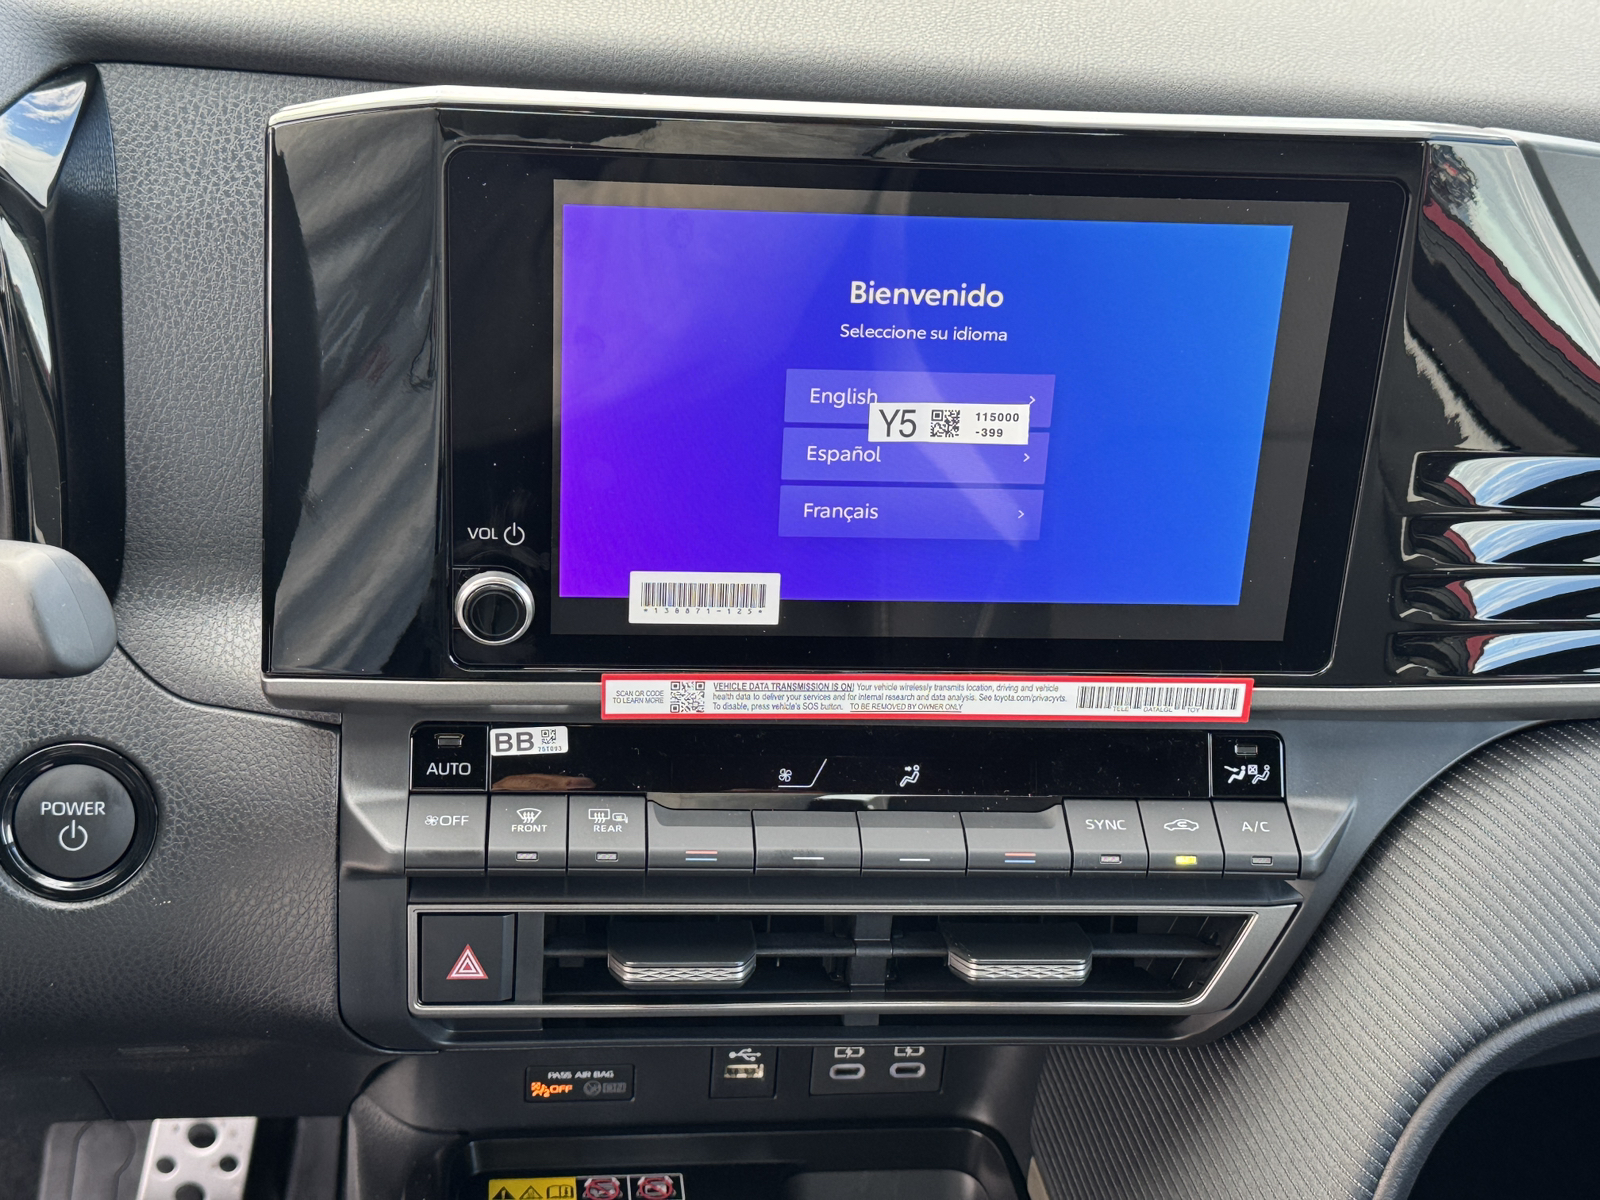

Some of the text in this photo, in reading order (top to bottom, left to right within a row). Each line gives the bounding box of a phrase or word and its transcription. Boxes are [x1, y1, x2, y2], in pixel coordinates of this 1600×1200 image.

[850, 280, 1004, 308] Bienvenido
[840, 323, 1008, 342] Seleccione su idioma
[810, 387, 878, 408] English
[975, 412, 1020, 422] 115000
[879, 409, 917, 437] Y5
[975, 428, 1004, 438] -399
[807, 445, 881, 465] Español
[803, 503, 879, 522] Français
[467, 527, 499, 540] VOL
[713, 682, 747, 690] VEHICLE
[749, 682, 769, 690] DATA
[771, 682, 829, 691] TRANSMISSION
[832, 682, 839, 691] IS
[857, 683, 872, 691] Your
[874, 683, 897, 691] vehicle
[900, 683, 932, 693] wirelessly
[934, 683, 965, 691] transmits
[966, 683, 994, 692] location,
[996, 684, 1019, 693] driving
[1020, 684, 1034, 692] and
[1035, 684, 1059, 692] vehicle
[713, 692, 734, 700] health
[735, 692, 751, 700] data
[762, 692, 785, 700] deliver
[786, 693, 802, 702] your
[858, 693, 884, 701] internal
[885, 693, 915, 701] research
[916, 693, 930, 701] and
[931, 693, 946, 701] data
[979, 693, 992, 701] See
[713, 702, 721, 710] To
[751, 703, 770, 711] press
[772, 702, 801, 710] vehicle's
[802, 702, 819, 710] SOS
[850, 702, 859, 710] TO
[861, 702, 870, 710] BE
[918, 703, 944, 711] OWNER
[945, 703, 963, 711] ONLY
[495, 731, 535, 753] BB
[426, 762, 471, 776] AUTO
[40, 801, 105, 816] POWER
[439, 815, 469, 826] OFF
[1085, 819, 1127, 831] SYNC
[511, 824, 547, 833] FRONT
[593, 824, 622, 833] REAR
[1242, 821, 1270, 832] A/C
[547, 1071, 572, 1079] PASS
[574, 1070, 592, 1079] AIR
[549, 1084, 573, 1094] OFF
